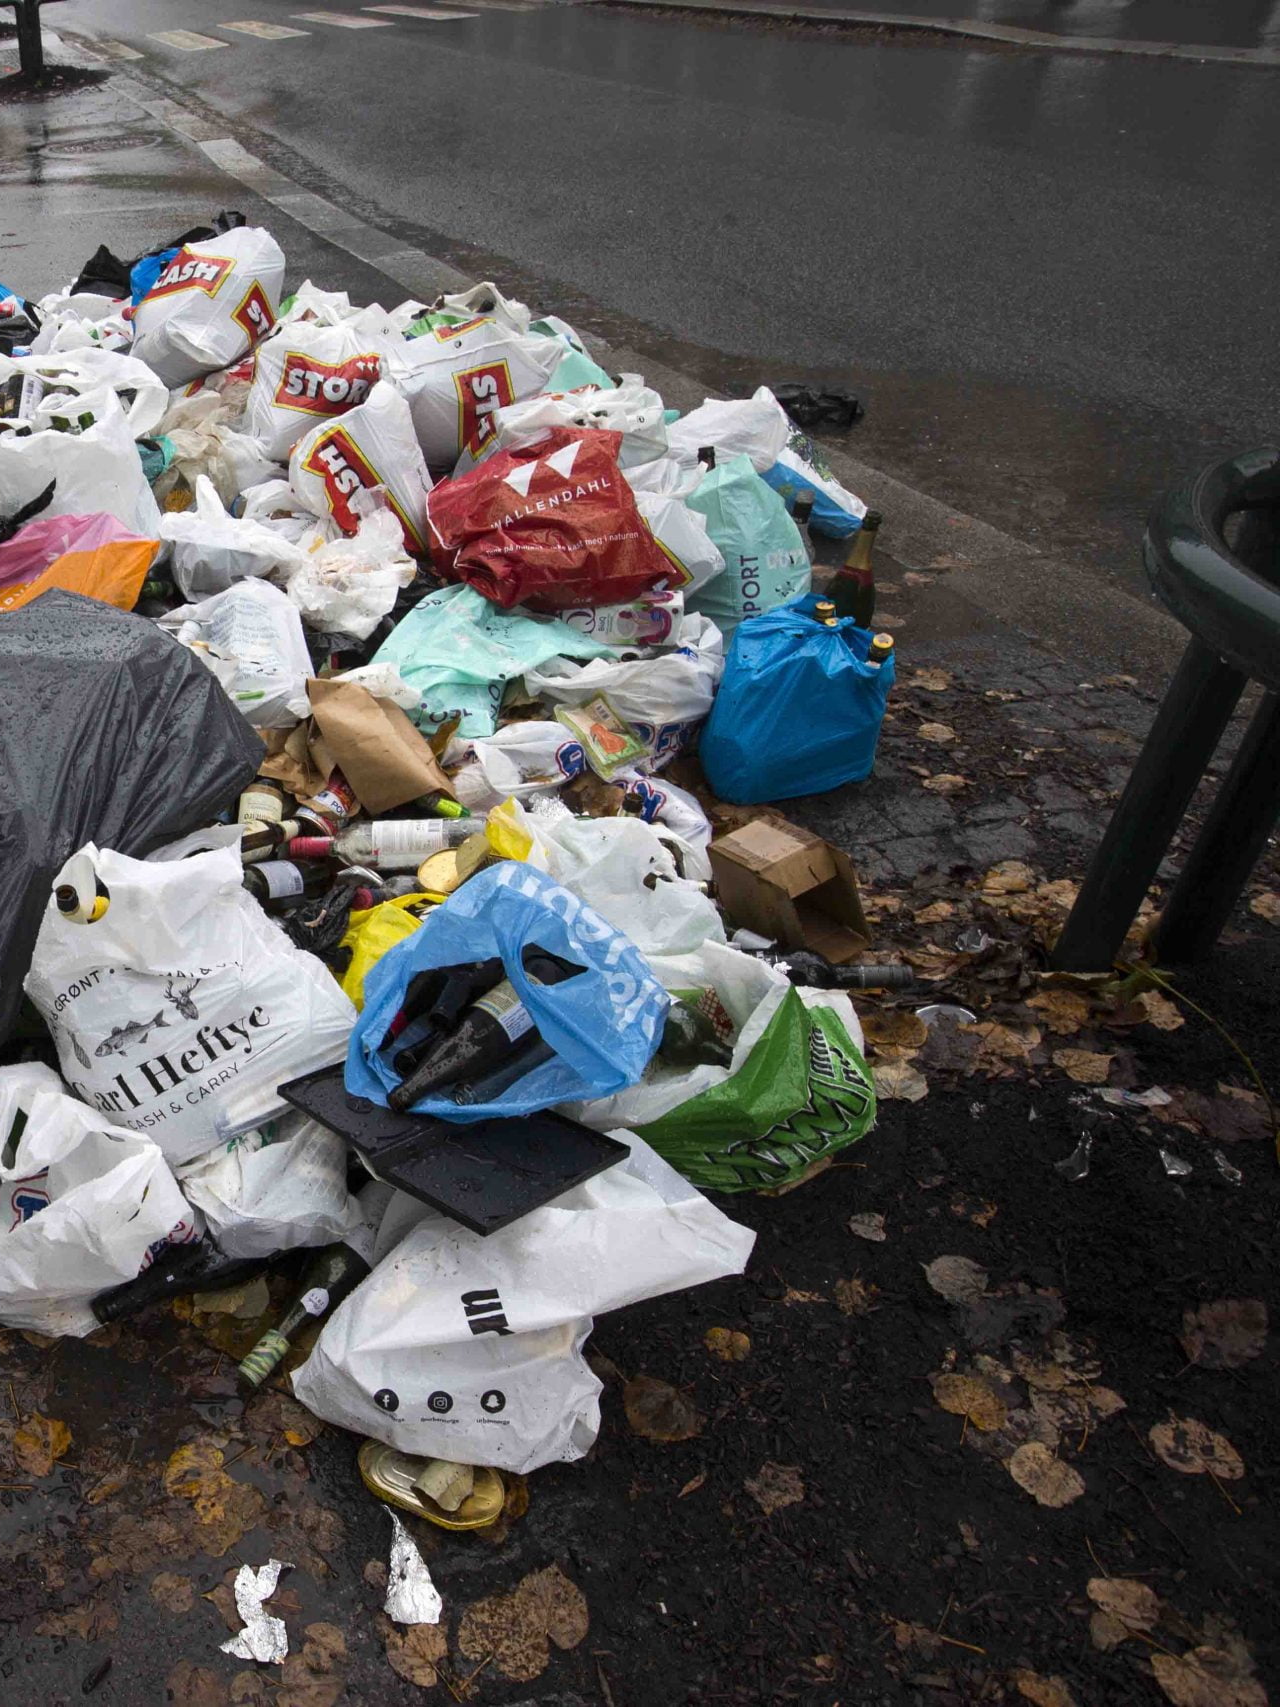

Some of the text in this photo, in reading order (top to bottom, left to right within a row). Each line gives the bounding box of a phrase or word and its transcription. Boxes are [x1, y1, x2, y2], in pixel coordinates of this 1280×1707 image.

[490, 477, 611, 529] WALLENDAHL
[740, 555, 761, 620] PORT
[53, 970, 102, 1013] GRØNT
[136, 1006, 270, 1097] Heftye
[127, 1062, 241, 1131] CASH & CARRY
